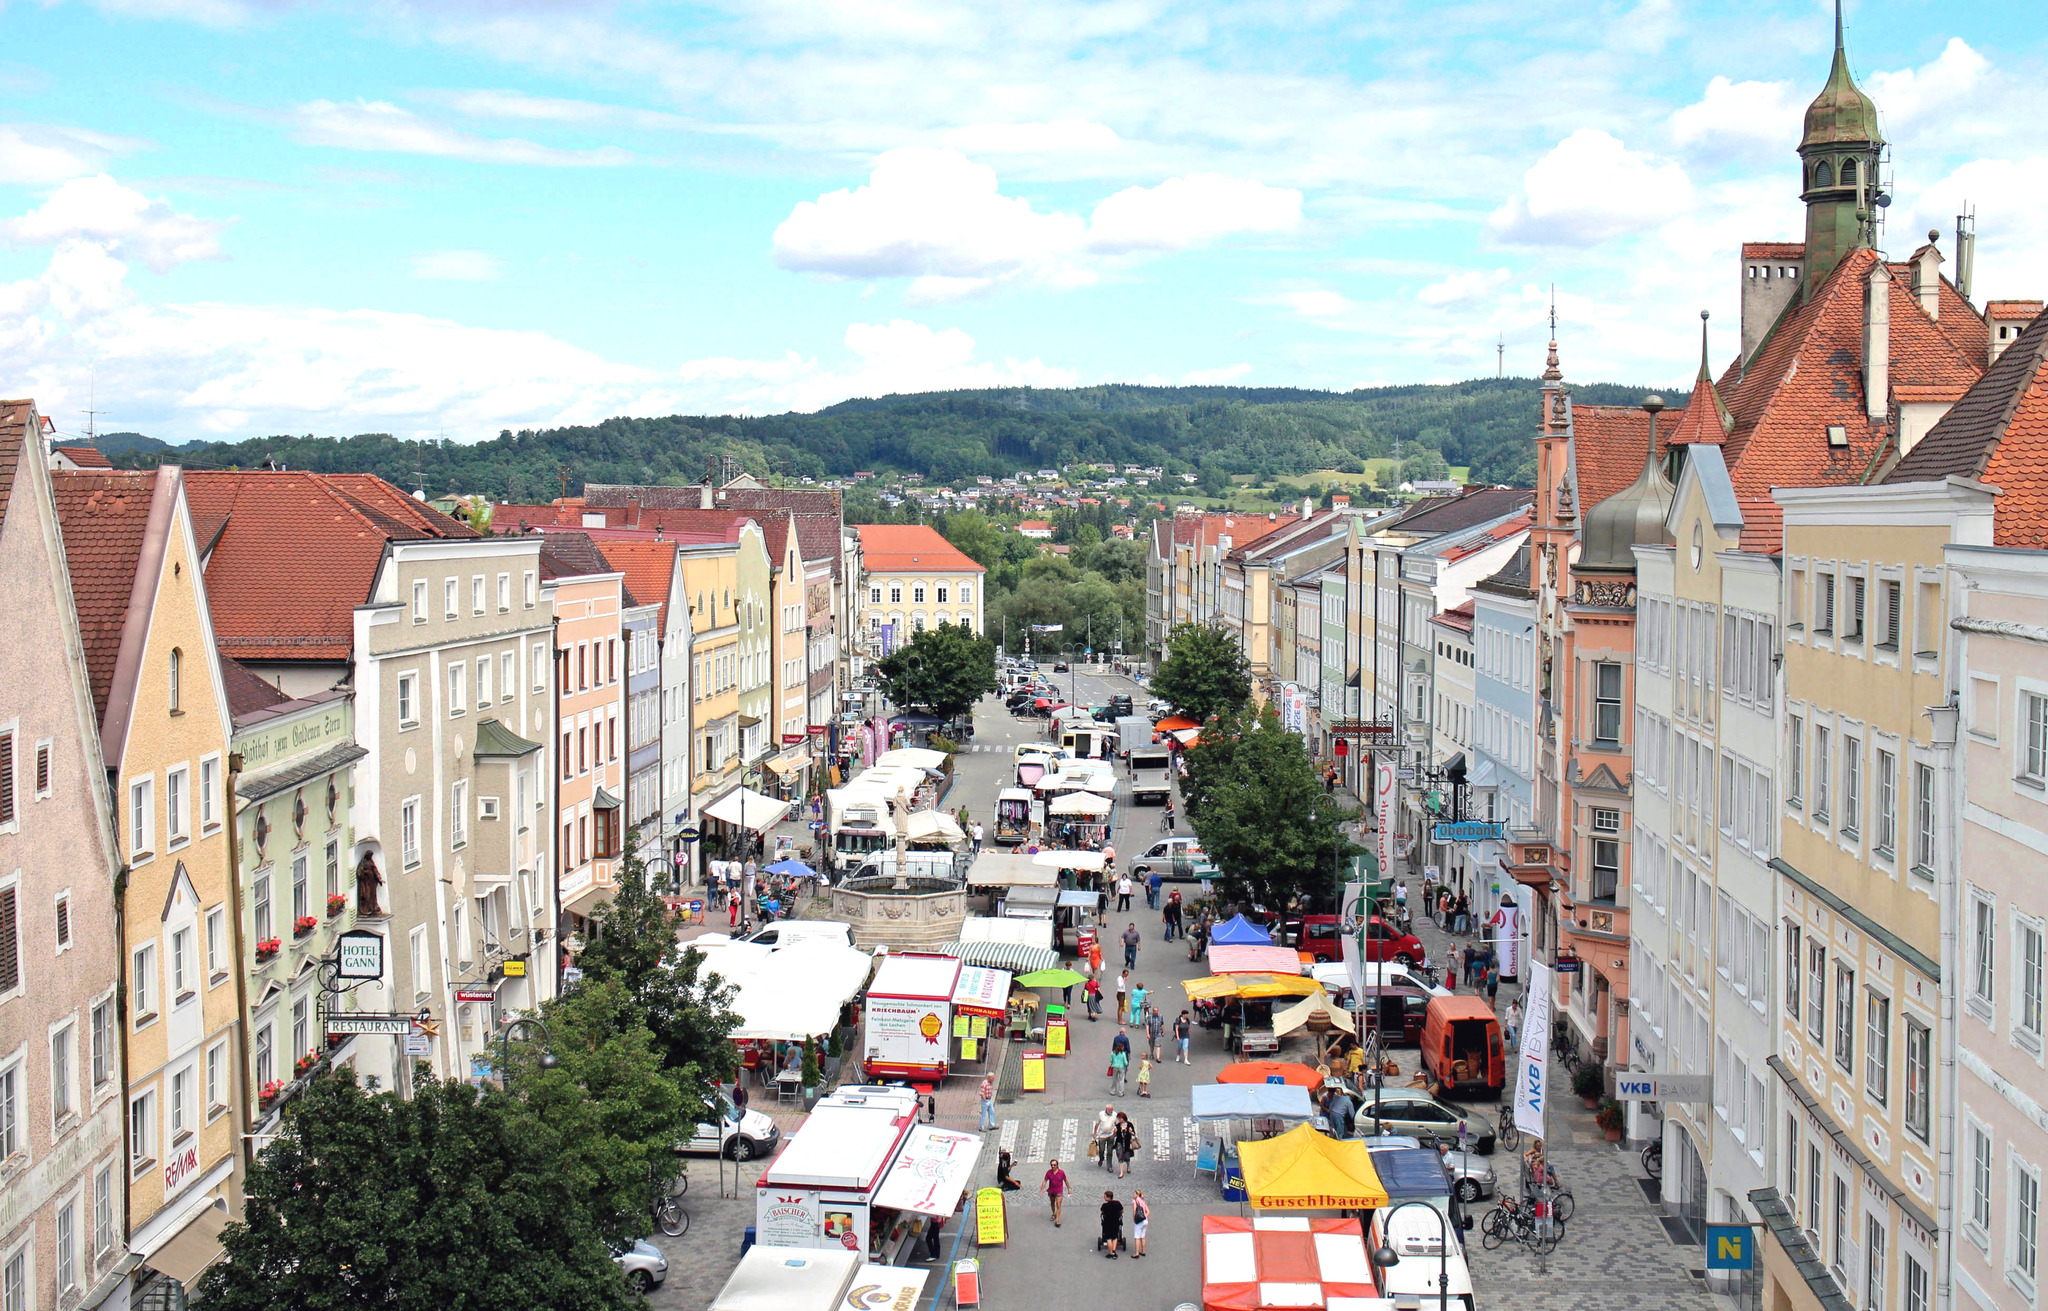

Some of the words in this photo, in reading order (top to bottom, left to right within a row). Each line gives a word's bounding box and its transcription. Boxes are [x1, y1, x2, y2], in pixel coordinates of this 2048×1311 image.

[274, 736, 288, 759] zum
[292, 723, 321, 747] Goldenen
[324, 715, 341, 735] Stern
[1440, 825, 1498, 837] Oberbank
[343, 945, 378, 957] HOTEL
[345, 957, 376, 968] GANN
[332, 1020, 406, 1032] RESTAURANT
[1620, 1082, 1651, 1094] VKB
[1660, 1083, 1702, 1096] BANK
[165, 1145, 198, 1191] RE/MAX
[1260, 1195, 1379, 1207] Guschlbauer
[771, 1207, 806, 1218] BAISCHER
